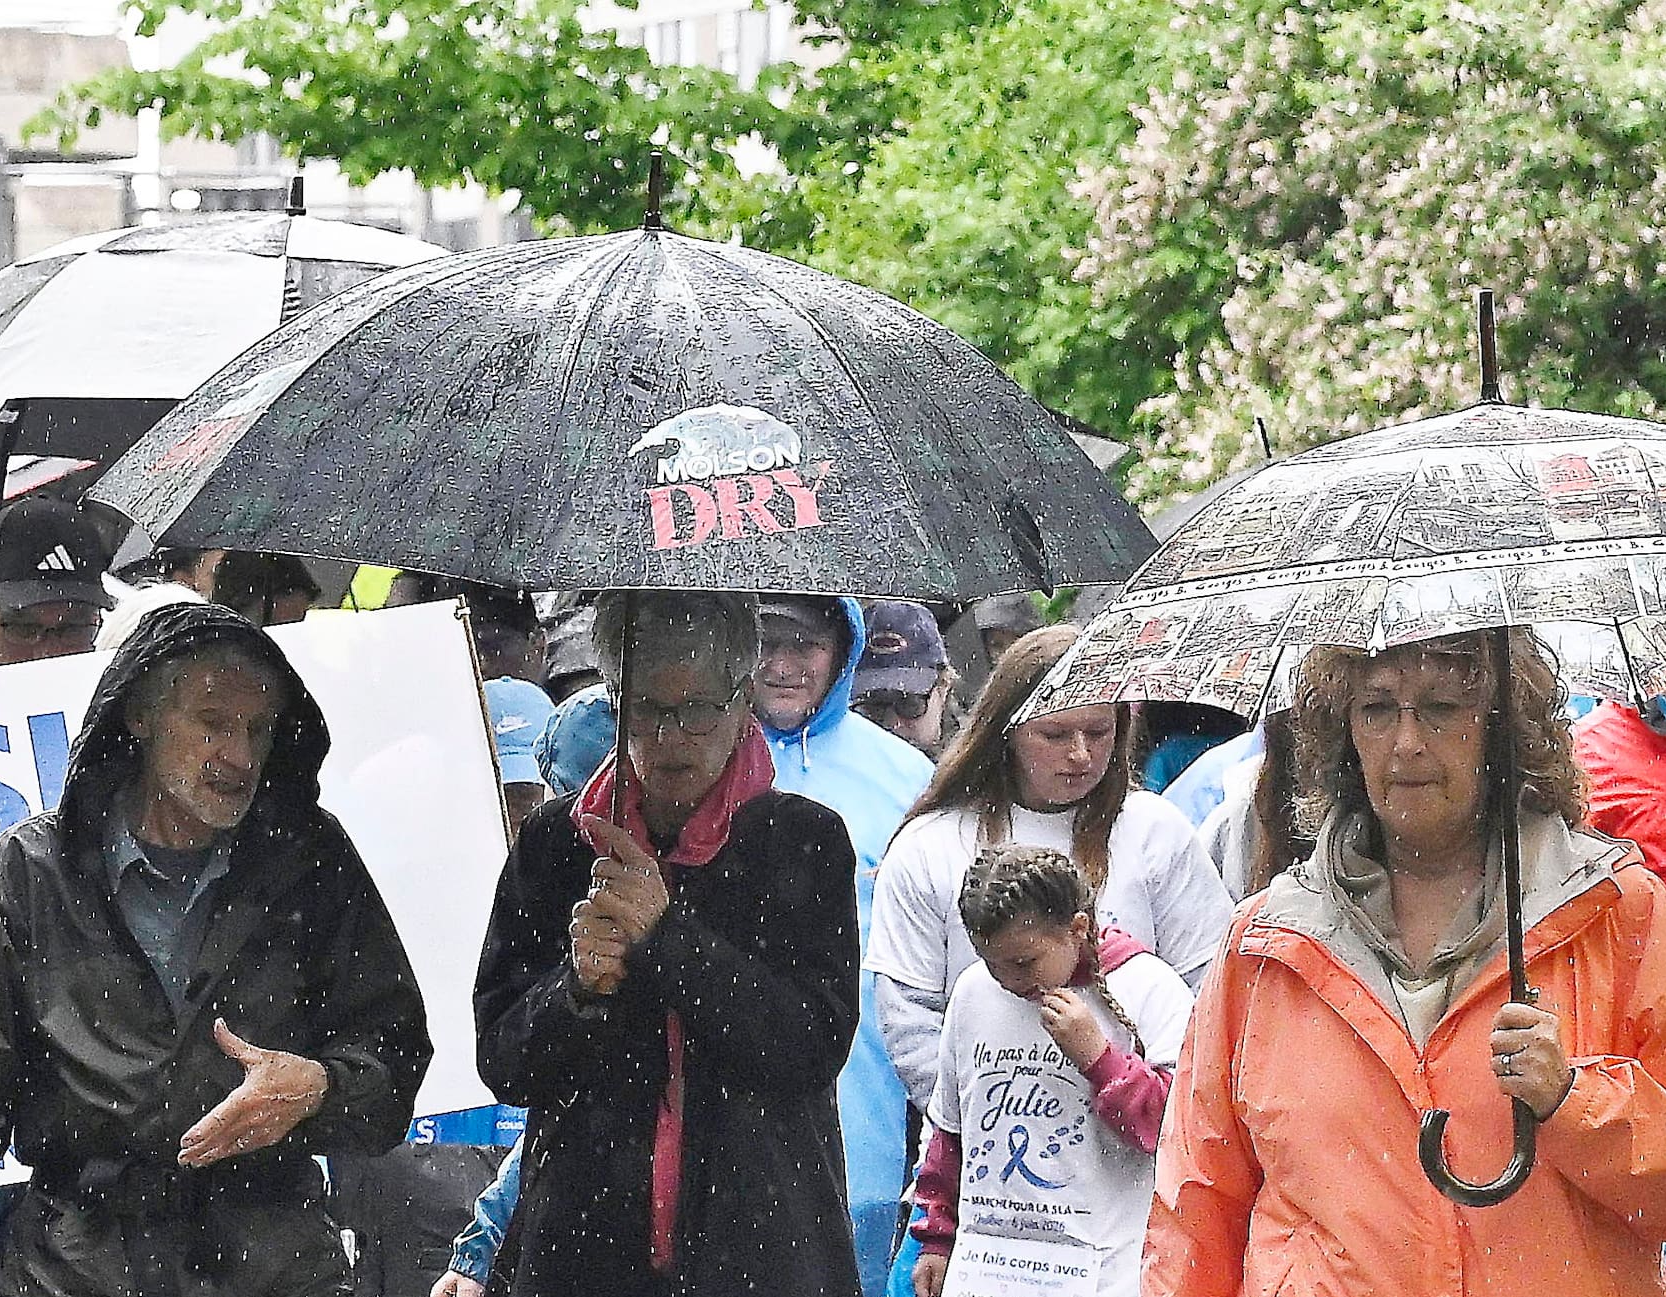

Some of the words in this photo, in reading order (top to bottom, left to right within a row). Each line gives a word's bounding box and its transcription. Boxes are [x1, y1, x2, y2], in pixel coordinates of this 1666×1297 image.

[656, 443, 801, 485] MOLSON
[641, 460, 835, 551] DRY
[995, 1048, 1025, 1068] pas
[1028, 1043, 1041, 1061] à
[1042, 1043, 1059, 1063] la
[1012, 1064, 1043, 1080] pour
[980, 1079, 1064, 1132] Julie
[961, 1250, 979, 1263] Je
[983, 1251, 1006, 1266] fais
[1009, 1257, 1050, 1273] corps
[1053, 1263, 1089, 1278] avec
